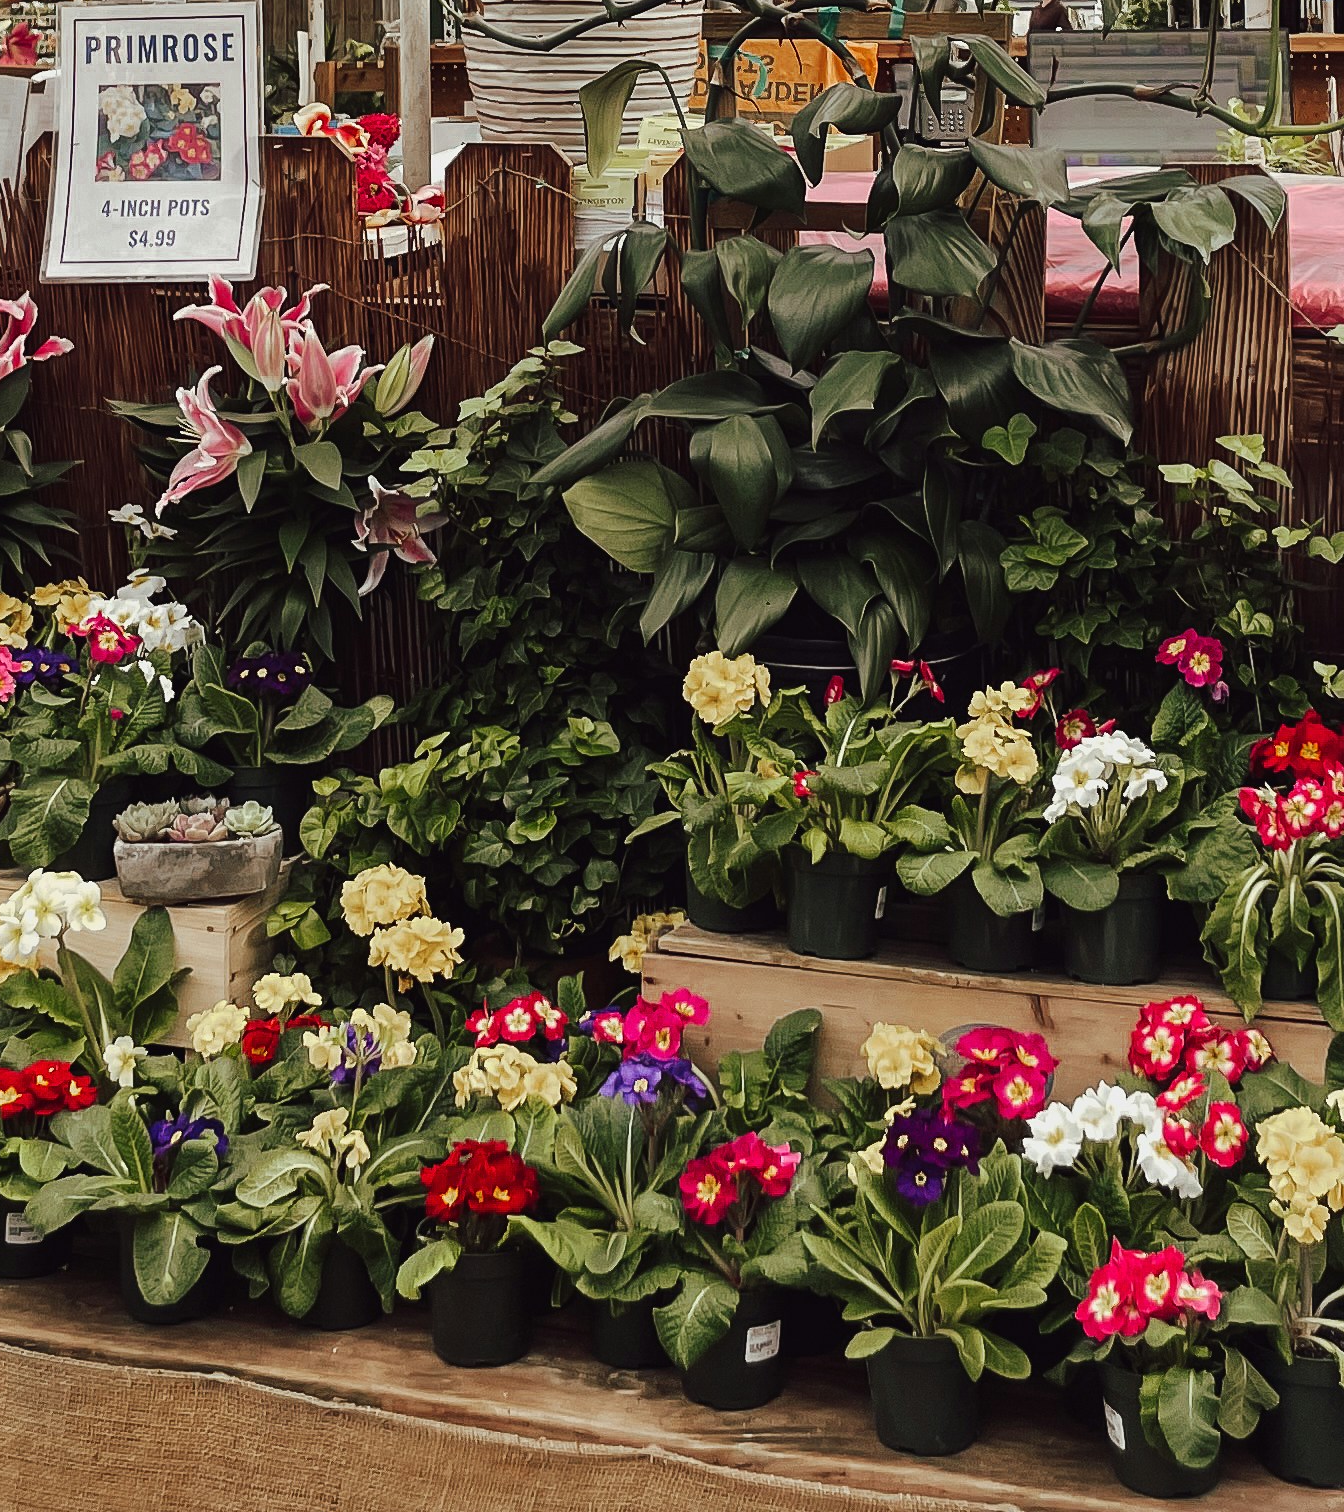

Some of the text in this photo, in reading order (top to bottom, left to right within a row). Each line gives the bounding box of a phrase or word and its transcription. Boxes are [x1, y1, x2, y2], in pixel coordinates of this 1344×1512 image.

[84, 32, 235, 65] PRIMROSE
[100, 198, 211, 218] 4-INCH POTS
[127, 228, 177, 249] $4.99
